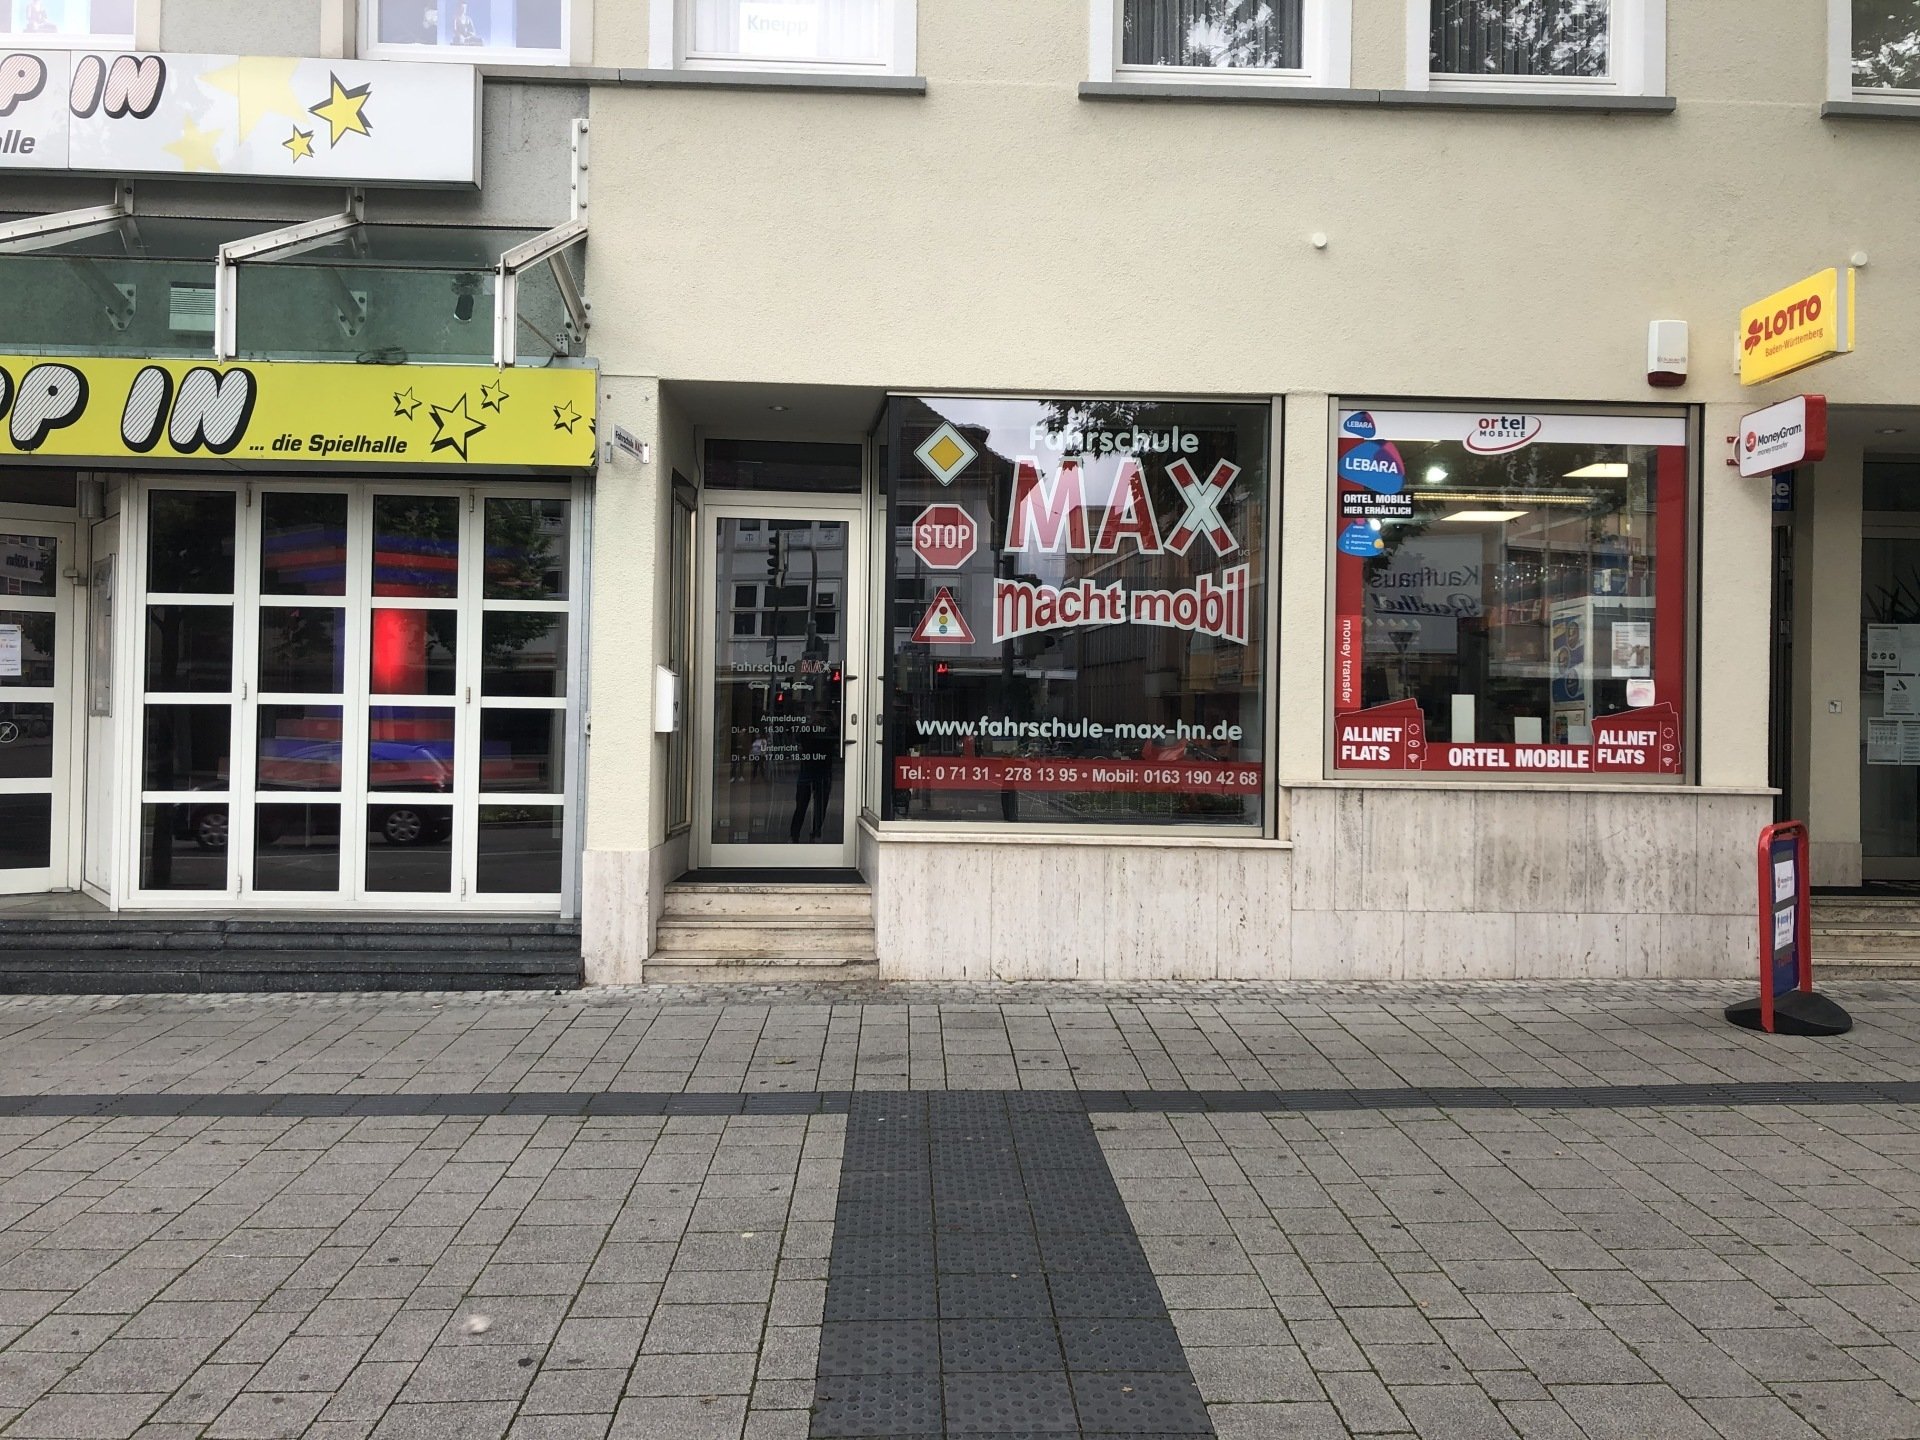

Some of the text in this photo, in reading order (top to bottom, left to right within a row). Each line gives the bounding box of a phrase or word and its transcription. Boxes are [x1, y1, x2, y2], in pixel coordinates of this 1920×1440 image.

[747, 14, 809, 37] Kneipp
[70, 55, 166, 119] IN
[0, 129, 36, 154] lle
[1764, 294, 1822, 341] LOTTO
[1765, 327, 1824, 357] Baden-Württemberg
[121, 365, 257, 455] IN
[1346, 420, 1373, 429] LEBARA
[1478, 415, 1526, 430] ortel
[1029, 424, 1199, 454] Fahrschule
[1479, 430, 1526, 438] MOBILE
[1757, 423, 1802, 446] MoneyGram
[271, 434, 303, 451] die
[308, 434, 408, 456] Spielhalle
[1345, 457, 1398, 474] LEBARA
[1004, 455, 1241, 557] MAX
[1343, 494, 1412, 504] ORTEL MOBILE
[1343, 504, 1412, 515] HIER ERHÄLTLICH
[919, 524, 970, 549] STOP
[993, 563, 1250, 646] macht mobil
[730, 659, 832, 673] Fahrschule MAX
[1340, 619, 1353, 703] money transfer
[760, 714, 807, 724] Anmeldung
[916, 716, 1243, 741] www.fahrschule-max-hn.de
[748, 726, 760, 734] Do
[790, 725, 811, 733] 17.00
[1342, 726, 1402, 743] ALLNET
[1598, 730, 1657, 746] ALLNET
[731, 754, 740, 762] Di
[748, 754, 760, 762] Do
[764, 753, 784, 761] 17.00
[790, 753, 811, 761] 18.30
[760, 744, 798, 752] Unterricht
[1341, 745, 1391, 761] FLATS
[1448, 748, 1589, 768] ORTEL MOBILE
[1597, 748, 1646, 765] FLATS
[900, 764, 931, 781] Tel.:
[935, 765, 946, 781] 0
[949, 765, 967, 781] 71
[972, 766, 990, 781] 31
[1004, 766, 1032, 782] 278
[1037, 767, 1055, 782] 13
[1059, 767, 1078, 783] 95
[1092, 767, 1139, 784] Mobil:
[1143, 768, 1181, 784] 0163
[1185, 768, 1212, 785] 190
[1215, 770, 1236, 786] 42
[1238, 770, 1258, 786] 68
